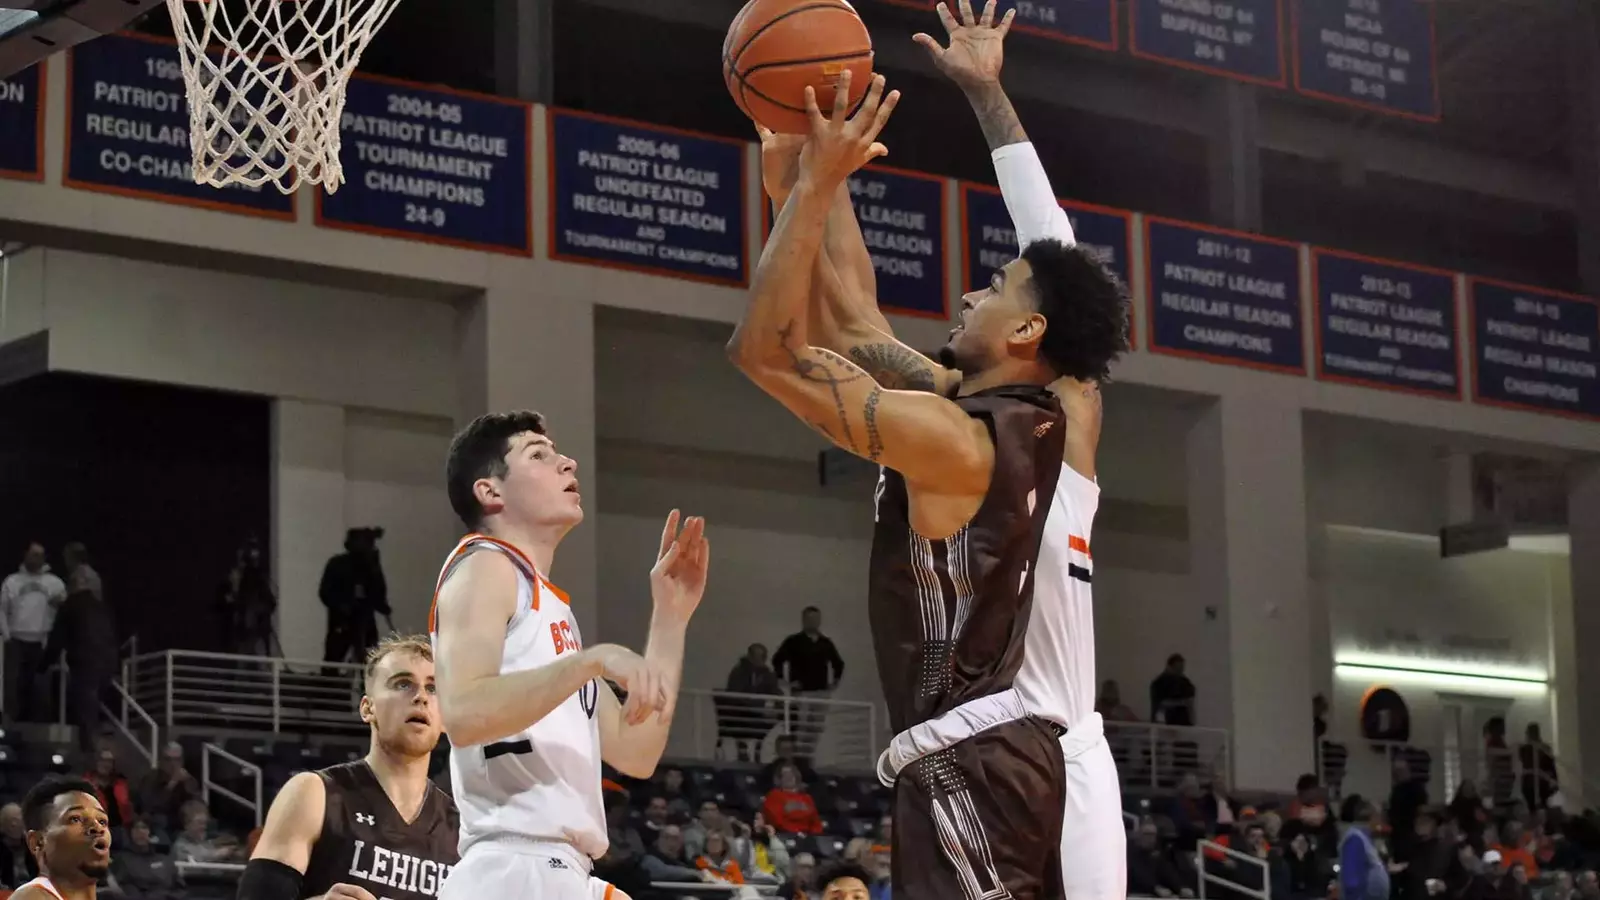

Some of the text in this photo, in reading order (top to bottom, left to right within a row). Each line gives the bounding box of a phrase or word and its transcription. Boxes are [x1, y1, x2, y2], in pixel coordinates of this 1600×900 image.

[94, 81, 180, 112] PATRIOT
[387, 94, 462, 124] 2004-05
[86, 113, 186, 147] REGULAR
[341, 112, 507, 157] PATRIOT LEAGUE
[356, 141, 493, 181] TOURNAMENT
[578, 150, 719, 188] PATRIOT LEAGUE
[365, 170, 485, 206] CHAMPIONS
[594, 176, 705, 207] UNDEFEATED
[405, 204, 445, 227] 24-9
[573, 193, 726, 233] REGULAR SEASON
[861, 204, 925, 230] LEAGUE
[565, 230, 738, 269] TOURNAMENT CHAMPIONS
[636, 224, 665, 241] AND
[864, 228, 932, 255] SEASON
[872, 255, 923, 278] PIONS
[1164, 263, 1285, 299] PATRIOT LEAGUE
[1161, 291, 1292, 329] REGULAR SEASON
[1330, 292, 1442, 326] PATRIOT LEAGUE
[1184, 323, 1272, 354] CHAMPIONS
[1328, 315, 1450, 349] REGULAR SEASON
